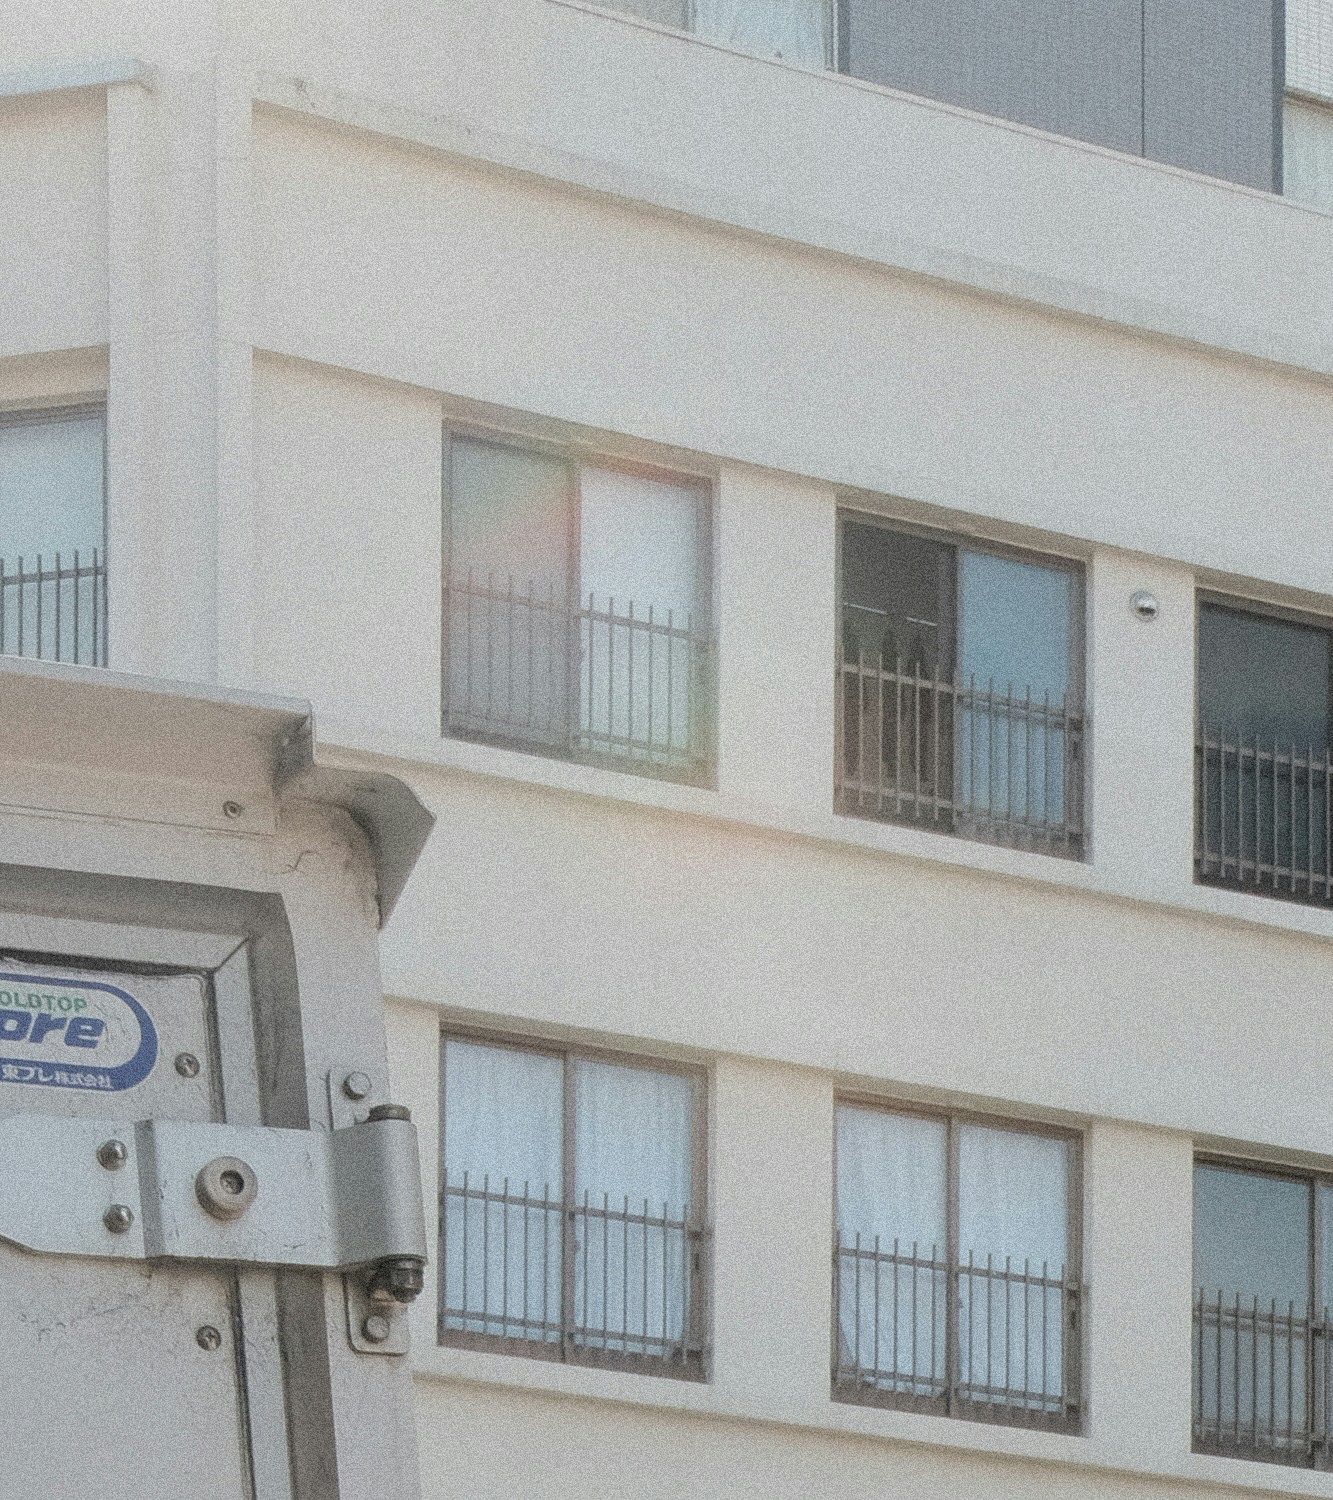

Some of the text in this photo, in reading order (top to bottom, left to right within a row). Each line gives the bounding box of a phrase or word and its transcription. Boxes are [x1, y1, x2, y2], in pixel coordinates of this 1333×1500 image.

[2, 1063, 114, 1090] 東プレ株式会社
